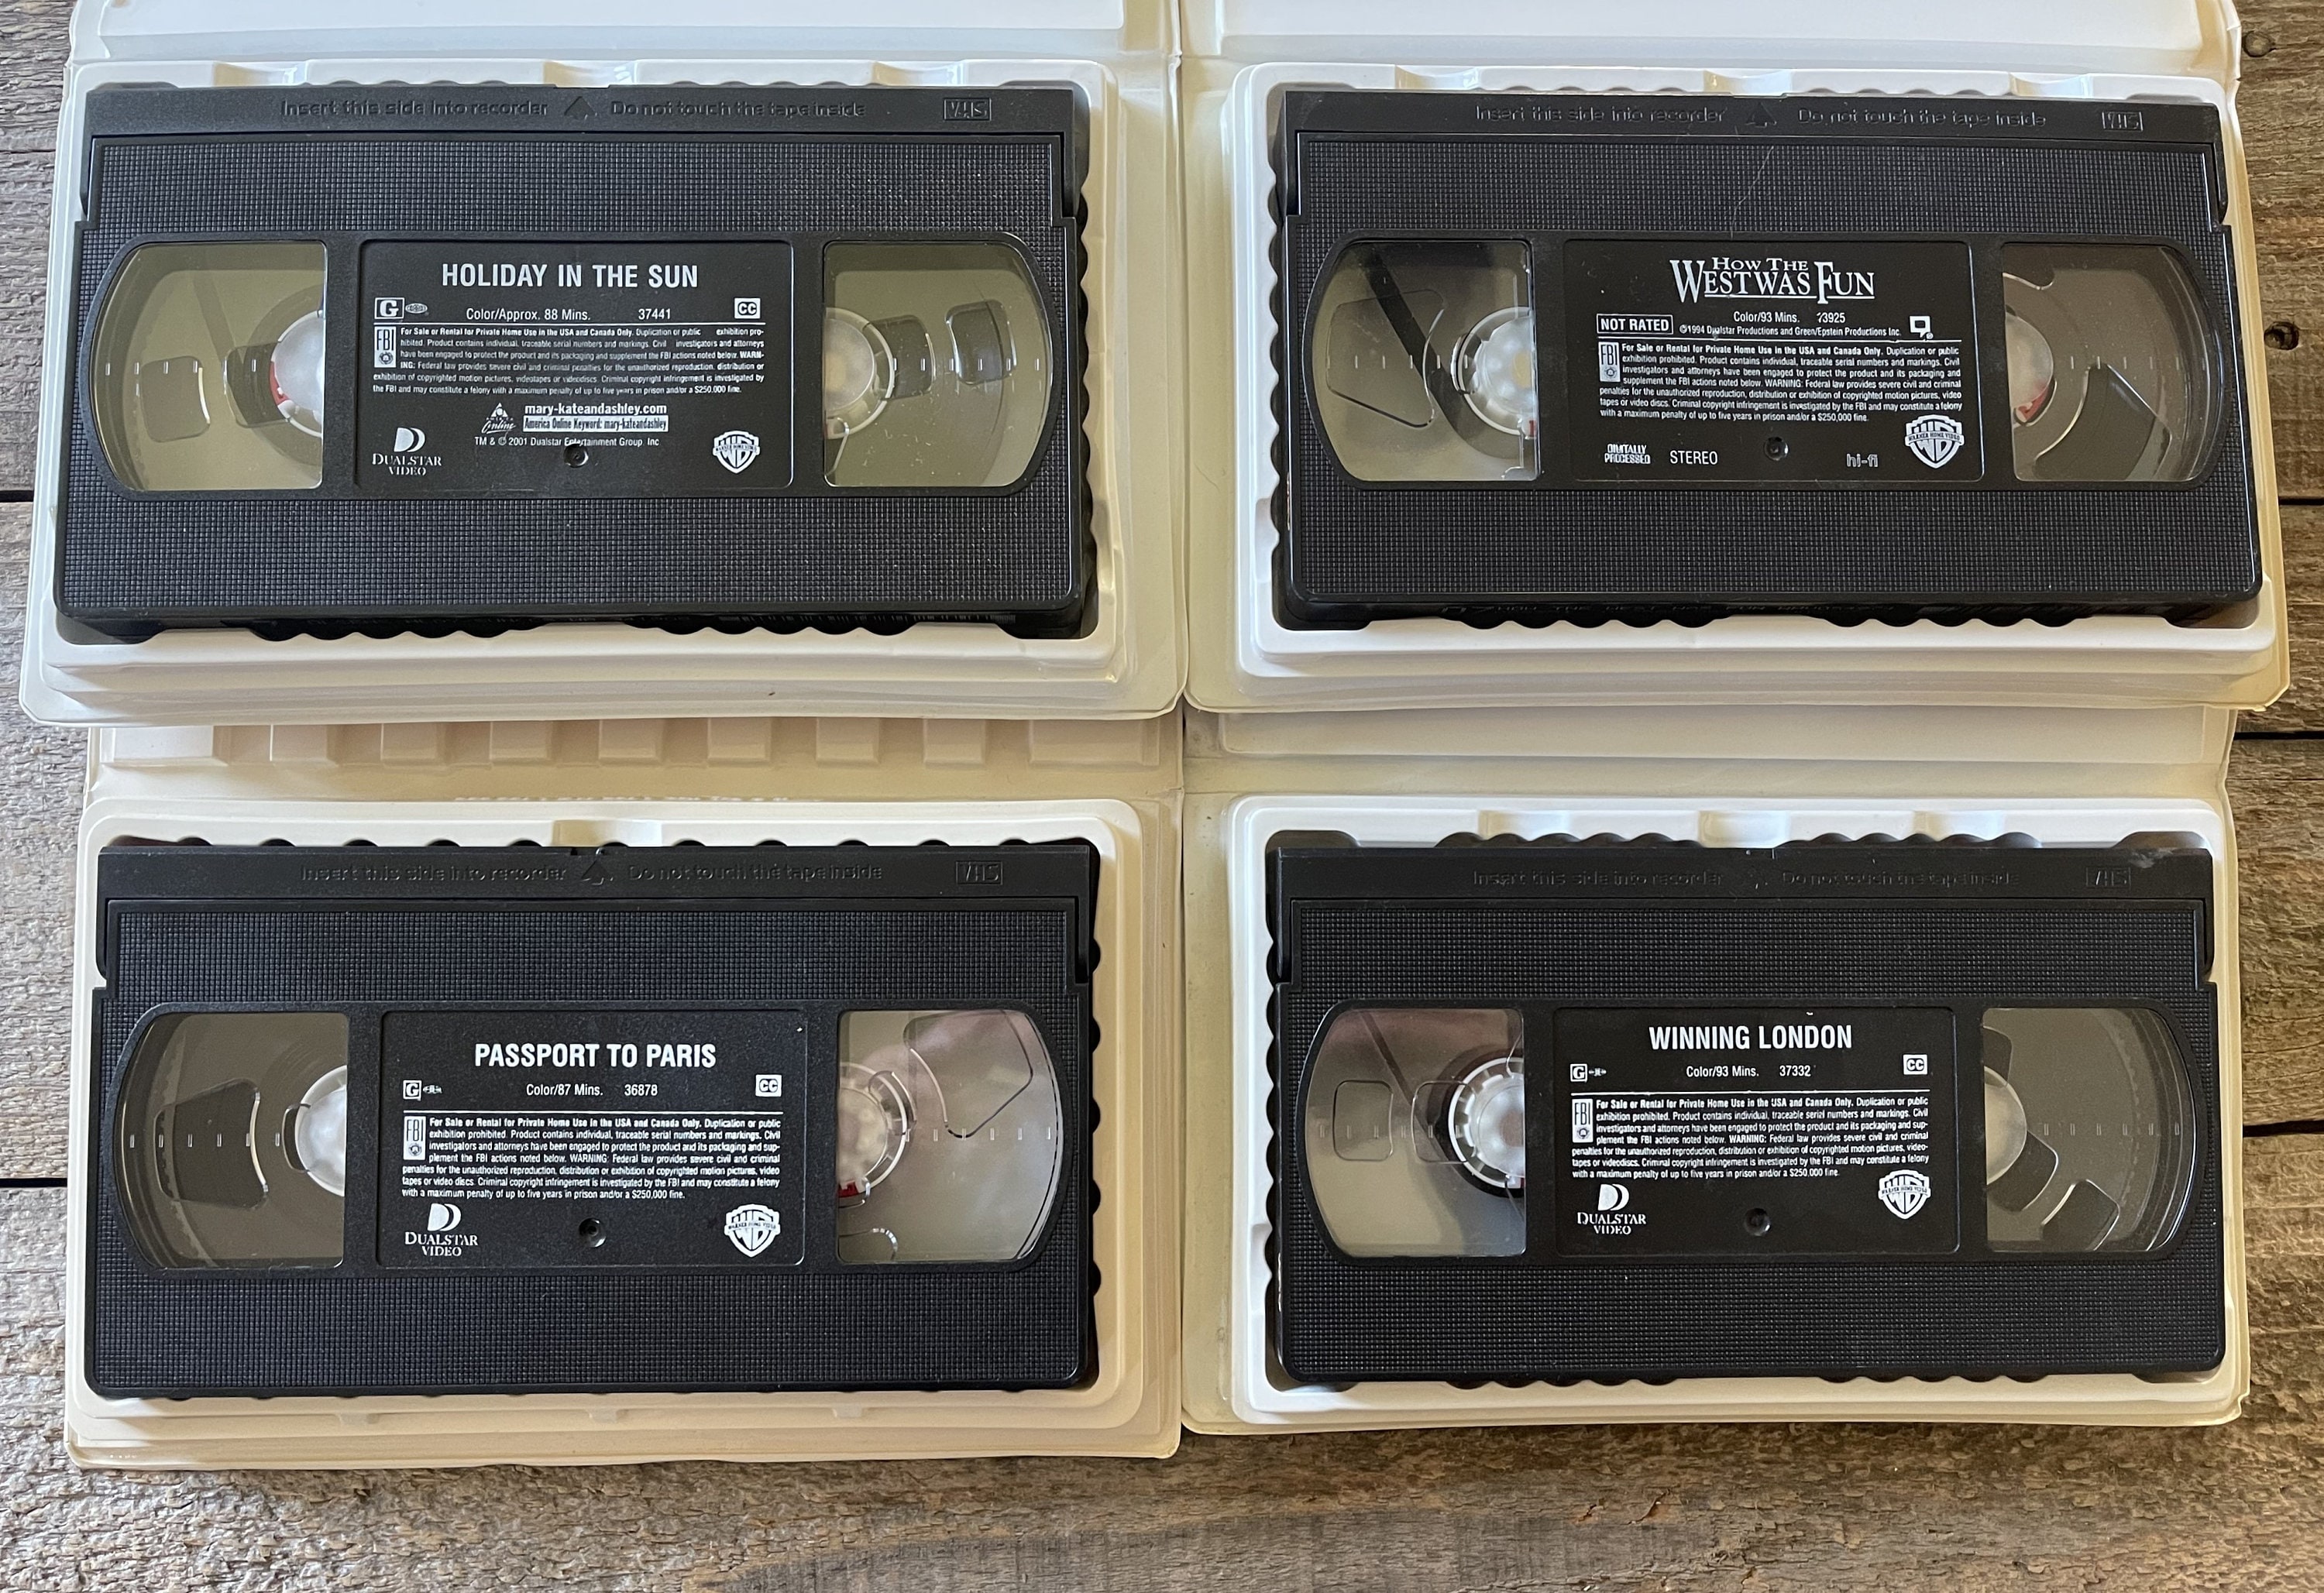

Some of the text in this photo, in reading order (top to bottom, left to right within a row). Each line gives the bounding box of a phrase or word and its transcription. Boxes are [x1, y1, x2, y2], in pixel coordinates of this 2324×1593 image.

[281, 101, 548, 116] Insert this side into recorder
[613, 102, 865, 118] Do not touch the tape inside
[949, 101, 987, 118] VHS
[442, 263, 697, 288] HOLIDAY IN THE SUN
[1755, 271, 1810, 295] WAS
[466, 308, 590, 321] Color/Approx. 88 Mins.
[638, 309, 670, 320] 37441
[1734, 311, 1800, 323] Color/93 Mins.
[1601, 318, 1669, 331] NOT RATED
[1737, 326, 1778, 335] Productions
[1781, 327, 1792, 335] and
[1795, 327, 1843, 337] Green/Epstein
[1845, 328, 1886, 336] Productions
[377, 328, 394, 350] FBI
[1600, 345, 1618, 366] FBI
[1622, 343, 1634, 352] For
[1666, 345, 1690, 353] Rental
[1693, 345, 1703, 353] for
[1706, 345, 1731, 354] Private
[1734, 345, 1755, 354] Home
[1758, 345, 1772, 355] Use
[1834, 347, 1861, 355] Canada
[1865, 347, 1883, 357] Only.
[525, 403, 666, 415] mary-kateandashley.com
[525, 417, 666, 431] America Online Keyword: mary-kateandashley
[475, 437, 486, 445] TM
[620, 438, 642, 447] Group
[1670, 451, 1718, 465] STEREO
[1846, 454, 1878, 467] hi-fi
[389, 466, 426, 476] VIDEO
[1649, 1025, 1852, 1049] WINNING LONDON
[475, 1043, 716, 1068] PASSPORT TO PARIS
[1686, 1066, 1758, 1077] Color/93 Mins.
[1779, 1066, 1810, 1076] 37332
[527, 1084, 603, 1096] Color/87 Mins.
[624, 1084, 658, 1096] 36878
[1597, 1100, 1607, 1108] For
[1611, 1100, 1627, 1109] Sale
[1641, 1100, 1663, 1108] Rental
[1666, 1100, 1676, 1108] for
[1679, 1099, 1704, 1108] Private
[1707, 1099, 1728, 1107] Home
[1731, 1099, 1745, 1107] Use
[1757, 1098, 1769, 1107] the
[1772, 1098, 1786, 1107] USA
[1789, 1098, 1802, 1107] and
[1805, 1098, 1832, 1107] Canada
[1835, 1097, 1853, 1107] Only.
[1575, 1102, 1590, 1125] FBI
[406, 1118, 423, 1141] FBI
[430, 1118, 442, 1127] For
[445, 1118, 462, 1127] Sale
[476, 1118, 501, 1127] Rental
[504, 1118, 514, 1127] for
[517, 1118, 545, 1127] Private
[548, 1118, 569, 1127] Home
[573, 1118, 587, 1127] Use
[600, 1118, 612, 1127] the
[615, 1119, 631, 1128] USA
[634, 1119, 648, 1128] and
[651, 1119, 679, 1128] Canada
[682, 1119, 701, 1129] Only.
[1577, 1212, 1646, 1224] DUALSTAR
[1593, 1225, 1631, 1234] VIDEO
[405, 1232, 478, 1246] DUALSTAR
[422, 1246, 462, 1257] VIDEO
